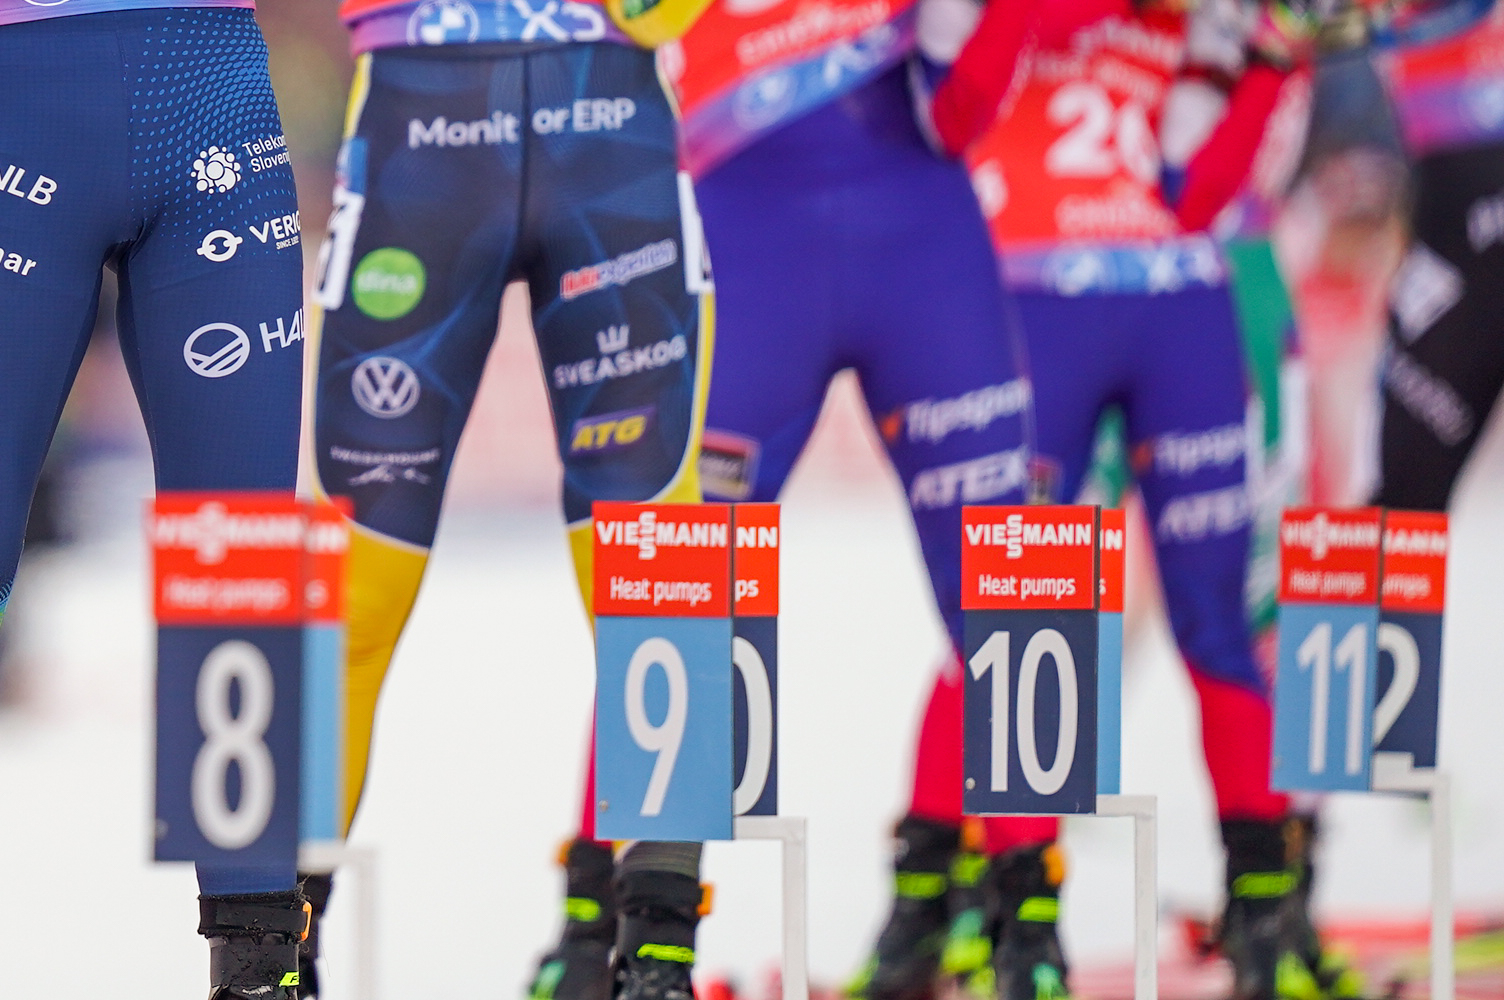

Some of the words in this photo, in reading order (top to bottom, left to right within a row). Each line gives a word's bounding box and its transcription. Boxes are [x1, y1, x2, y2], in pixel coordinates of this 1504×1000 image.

[242, 134, 287, 157] Teleko
[570, 414, 648, 452] ATG
[596, 511, 728, 560] VIESSMANN
[965, 514, 1092, 559] VIESSMANN
[1282, 512, 1379, 561] VIESSMANN
[610, 575, 651, 600] Heat
[653, 578, 712, 606] pumps
[978, 573, 1017, 595] Heat
[1021, 577, 1076, 600] pumps
[968, 628, 1079, 796] 10
[1298, 622, 1367, 776] 11
[192, 638, 277, 851] 8
[624, 636, 689, 817] 9
